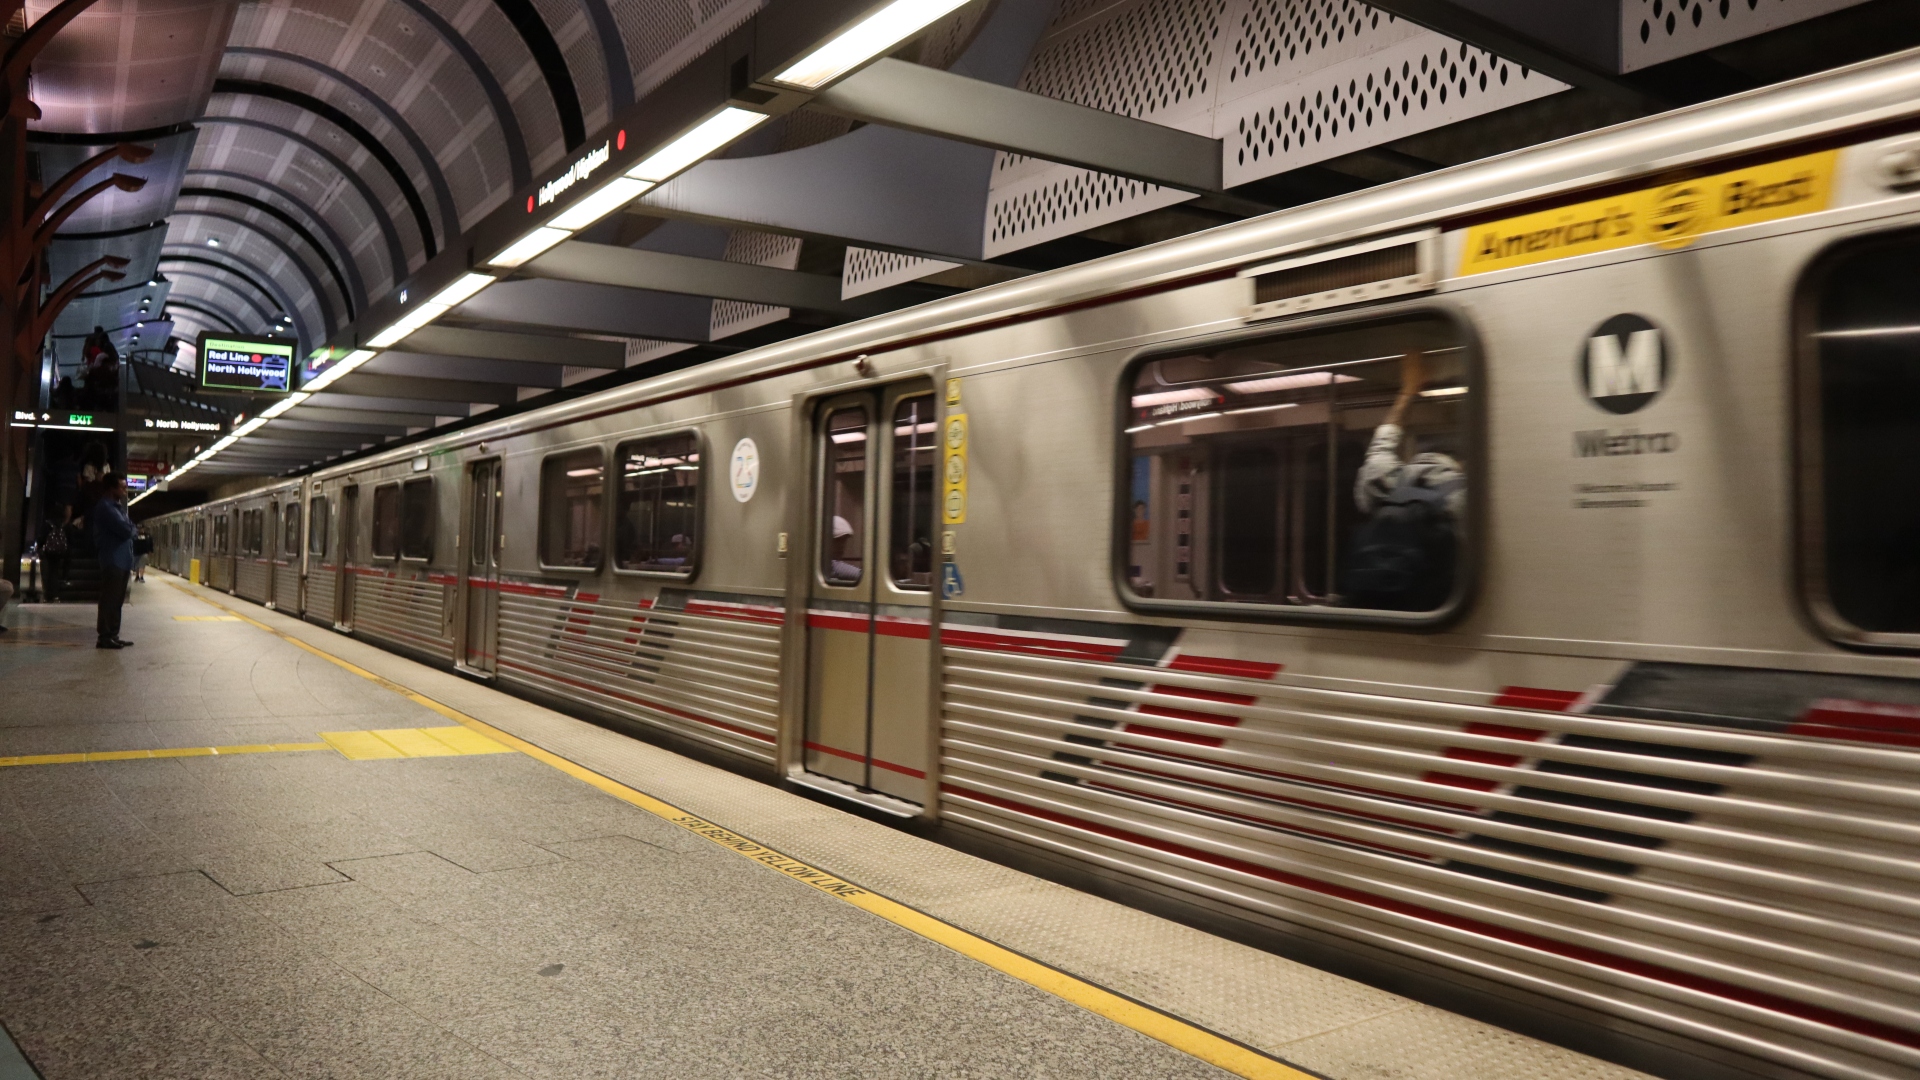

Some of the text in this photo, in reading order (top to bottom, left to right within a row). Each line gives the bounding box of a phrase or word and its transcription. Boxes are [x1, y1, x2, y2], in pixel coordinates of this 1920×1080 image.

[538, 139, 609, 206] Hollywood/Highland
[1720, 170, 1815, 217] Best
[208, 350, 250, 363] Red Line
[207, 363, 286, 378] North Hollywood
[14, 410, 93, 426] Blvd. EXIT
[144, 418, 220, 432] To North Hollywood
[1573, 428, 1681, 458] Metro
[672, 816, 866, 898] STAY BEHIND YELLOW LINE
